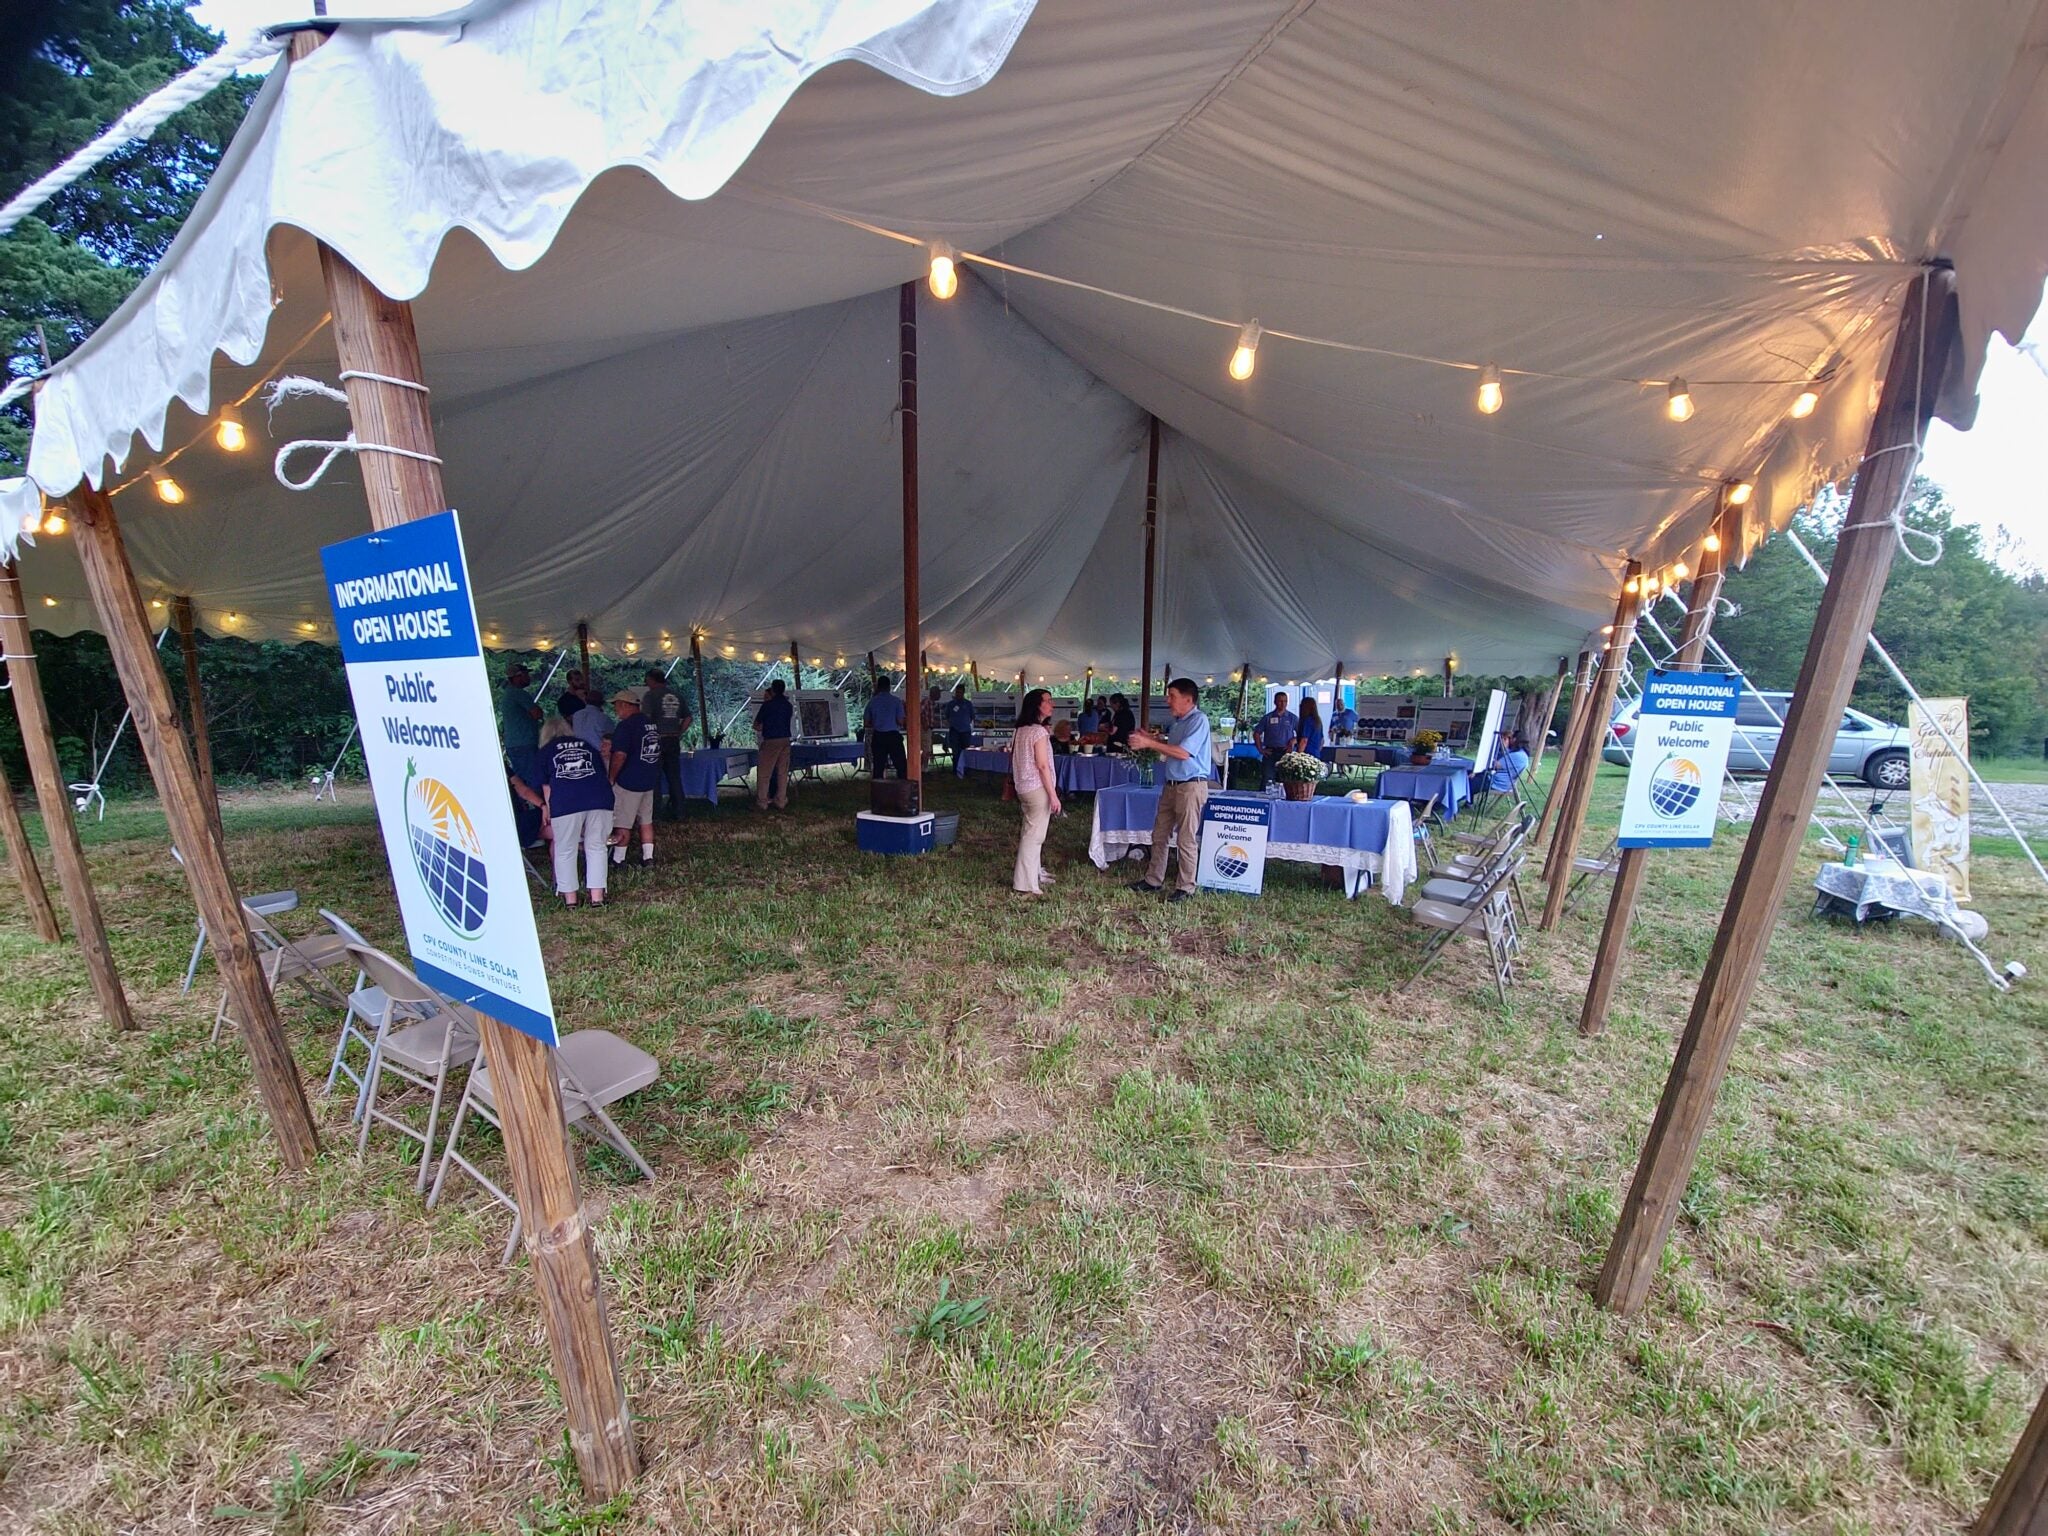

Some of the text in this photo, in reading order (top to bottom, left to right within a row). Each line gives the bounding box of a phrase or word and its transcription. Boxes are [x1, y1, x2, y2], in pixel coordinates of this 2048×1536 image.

[335, 561, 458, 609] INFORMATIONAL
[353, 608, 452, 645] OPEN HOUSE
[385, 671, 437, 703] Public
[1651, 683, 1735, 698] INFORMATIONAL
[1656, 698, 1725, 712] OPEN HOUSE
[382, 716, 460, 749] Welcome
[1669, 720, 1704, 732] Public
[1658, 736, 1710, 748] Welcome
[1210, 805, 1266, 815] INFORMATIONAL
[1214, 812, 1260, 822] OPEN HOUSE
[1223, 824, 1247, 833] Public
[1217, 832, 1252, 842] Welcome
[423, 933, 519, 981] CPV COUNTY LINE SOLAR
[426, 948, 521, 993] COMPETITIVE POWER VENTURES
